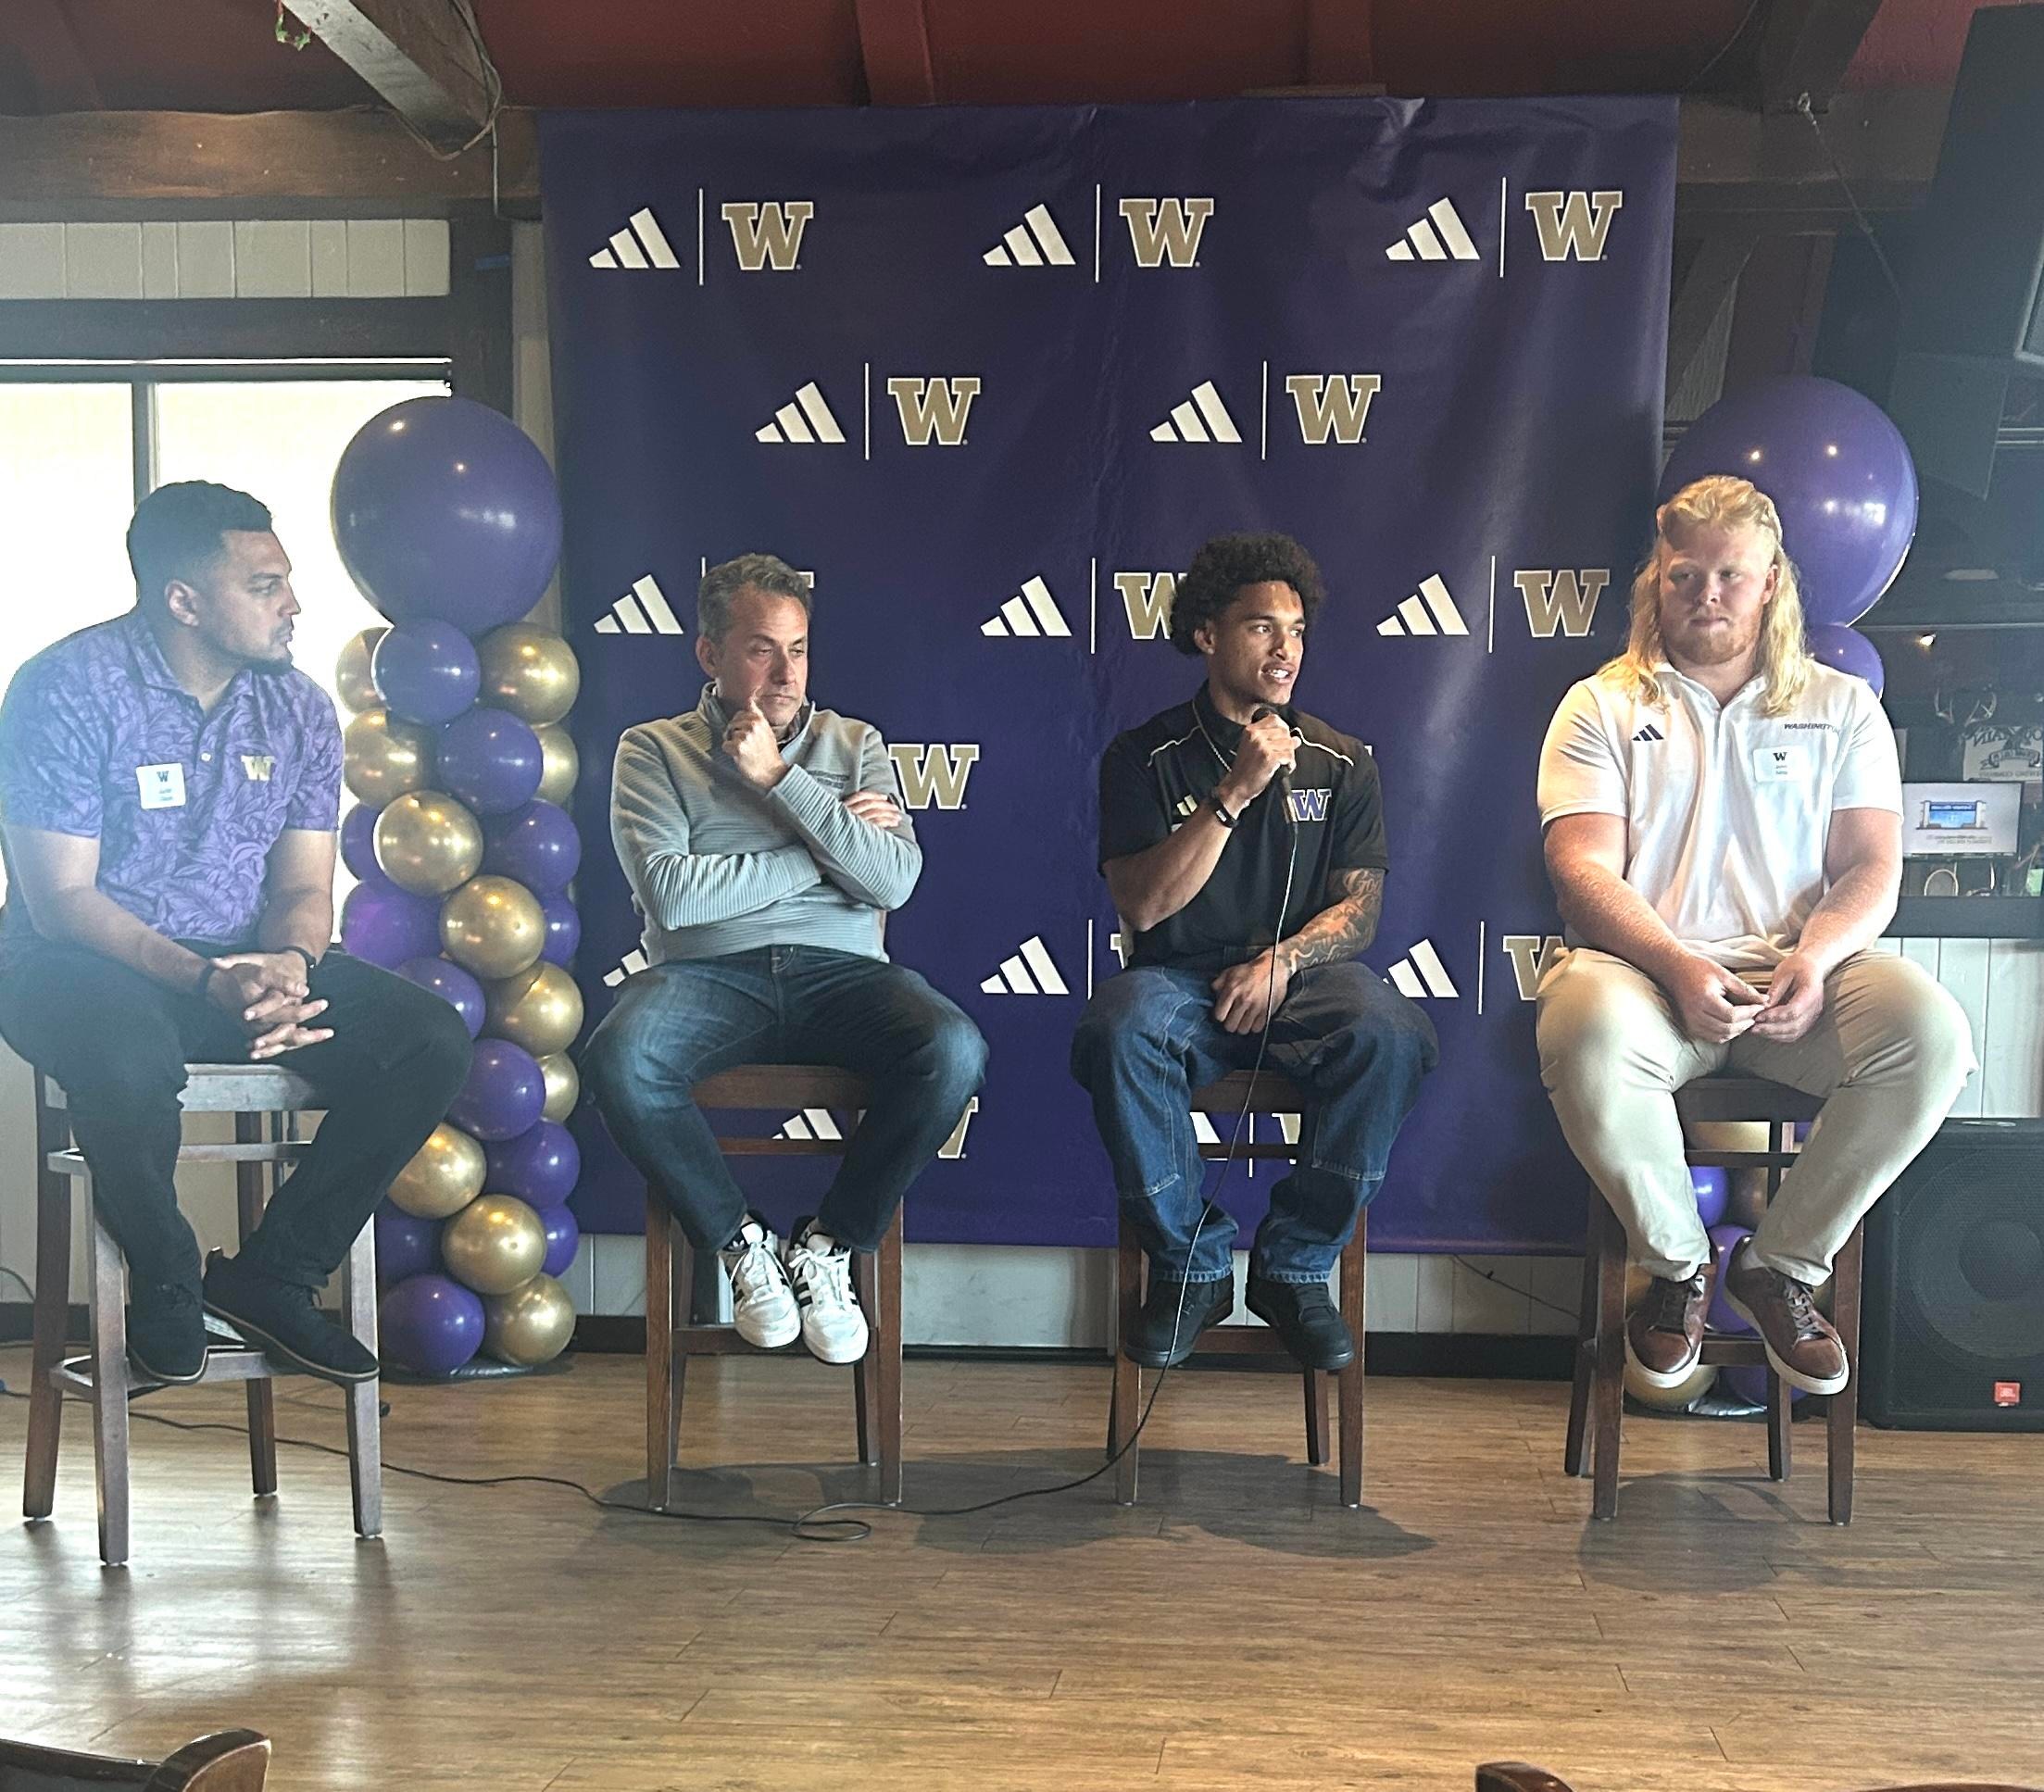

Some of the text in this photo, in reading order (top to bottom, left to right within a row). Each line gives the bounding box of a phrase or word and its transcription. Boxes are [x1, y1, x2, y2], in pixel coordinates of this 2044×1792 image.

[721, 201, 814, 270] W
[1119, 197, 1214, 268] W
[1525, 191, 1623, 262] W
[887, 377, 981, 445] W
[1285, 374, 1381, 445] W
[1113, 572, 1185, 640] W
[1513, 569, 1610, 638] W
[157, 770, 169, 783] W
[241, 755, 276, 782] W
[888, 744, 980, 810] W
[1773, 752, 1787, 761] W
[1291, 788, 1332, 821] W
